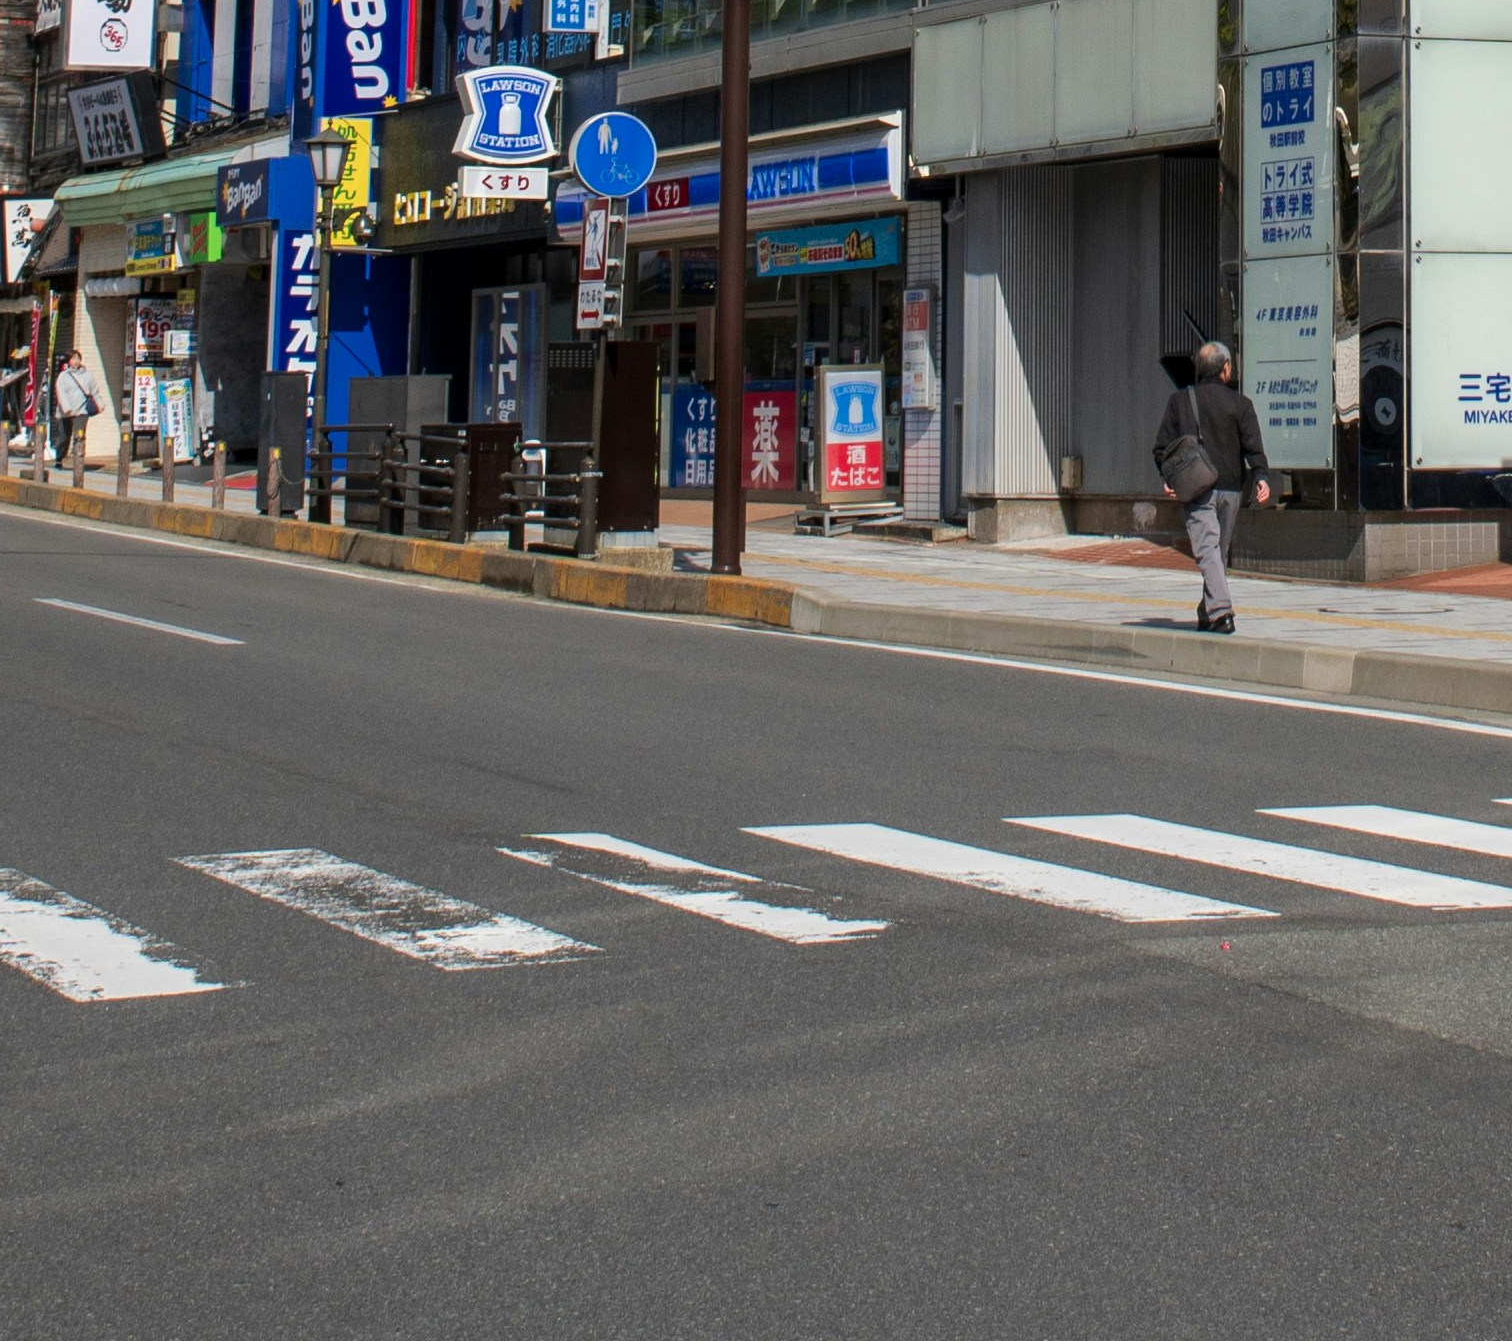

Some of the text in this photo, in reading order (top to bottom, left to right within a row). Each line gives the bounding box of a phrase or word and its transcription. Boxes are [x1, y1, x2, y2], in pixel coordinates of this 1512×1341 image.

[481, 78, 542, 95] LAWSON
[1262, 65, 1313, 94] 個別教室
[1262, 95, 1312, 122] のトライ
[479, 132, 541, 149] STATION
[1269, 129, 1306, 148] 秋田駅前校
[482, 174, 531, 191] くすり
[654, 157, 817, 206] くすり AWSON
[1264, 162, 1313, 190] トライ式
[226, 178, 262, 213] BanBan
[1262, 191, 1313, 220] 高等学院
[1262, 223, 1312, 243] 秋田キャンパス
[1256, 304, 1318, 321] 4F 東京美容外科
[833, 384, 877, 396] LAWSON
[1256, 381, 1266, 394] 2F
[833, 422, 877, 433] STATION
[750, 400, 780, 484] 薬
[845, 444, 867, 465] 酒
[830, 466, 881, 487] たばこ
